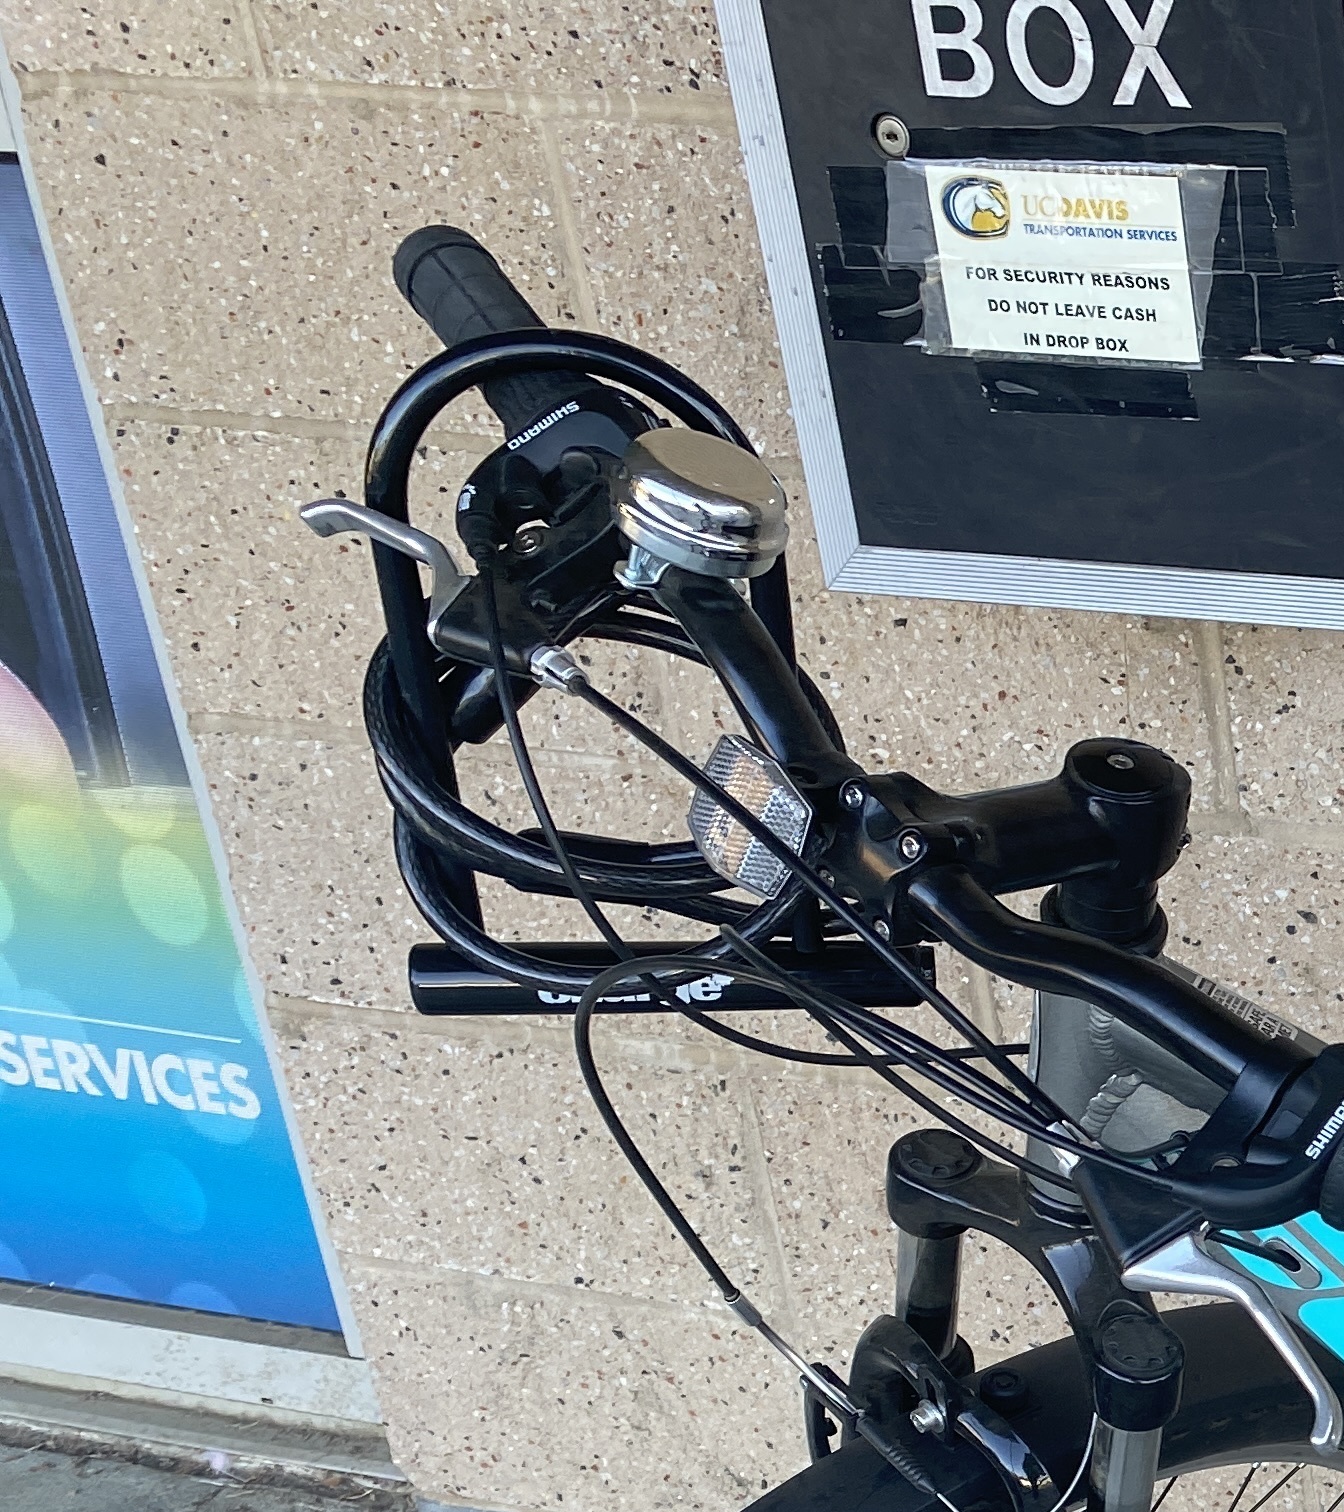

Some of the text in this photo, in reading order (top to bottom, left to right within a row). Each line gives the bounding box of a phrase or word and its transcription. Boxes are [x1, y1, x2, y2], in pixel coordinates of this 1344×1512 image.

[911, 0, 1192, 109] BOX
[1023, 223, 1178, 242] TRANSPORTATION SERVICES
[965, 266, 1170, 291] FOR SECURITY REASONS
[987, 299, 1156, 322] DO NOT LEAVE CASH
[1023, 332, 1129, 352] IN DROP BOX
[507, 401, 580, 450] SHIMANO
[0, 1030, 261, 1120] SERVICES
